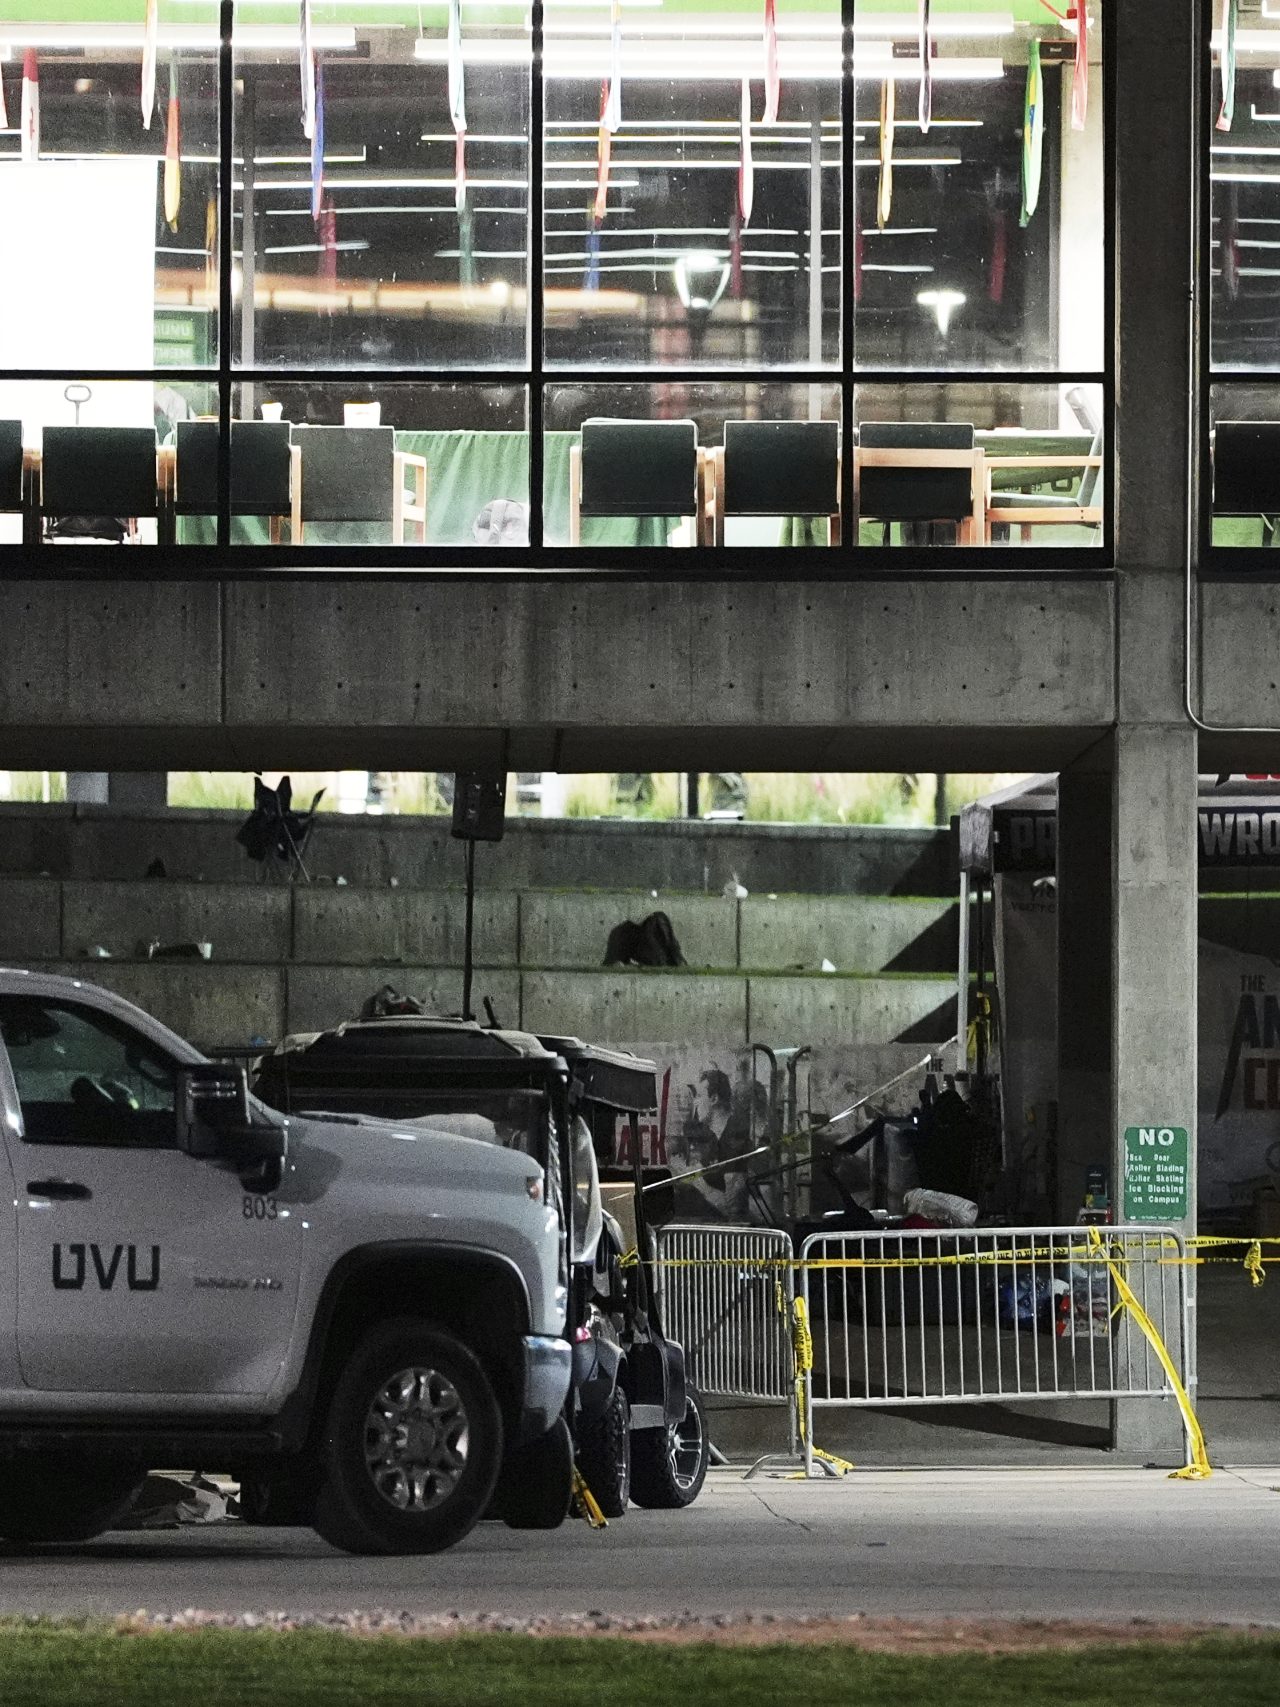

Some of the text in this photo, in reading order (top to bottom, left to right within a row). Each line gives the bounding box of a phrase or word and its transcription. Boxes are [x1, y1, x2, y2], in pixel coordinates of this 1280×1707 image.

[1240, 974, 1266, 992] THE
[1139, 1128, 1174, 1146] NO
[1156, 1164, 1184, 1174] Blading
[1155, 1174, 1184, 1184] Skating
[1128, 1184, 1184, 1195] Ice Blocking
[1148, 1195, 1180, 1205] Campus
[242, 1196, 278, 1221] 803
[52, 1243, 161, 1290] UVU
